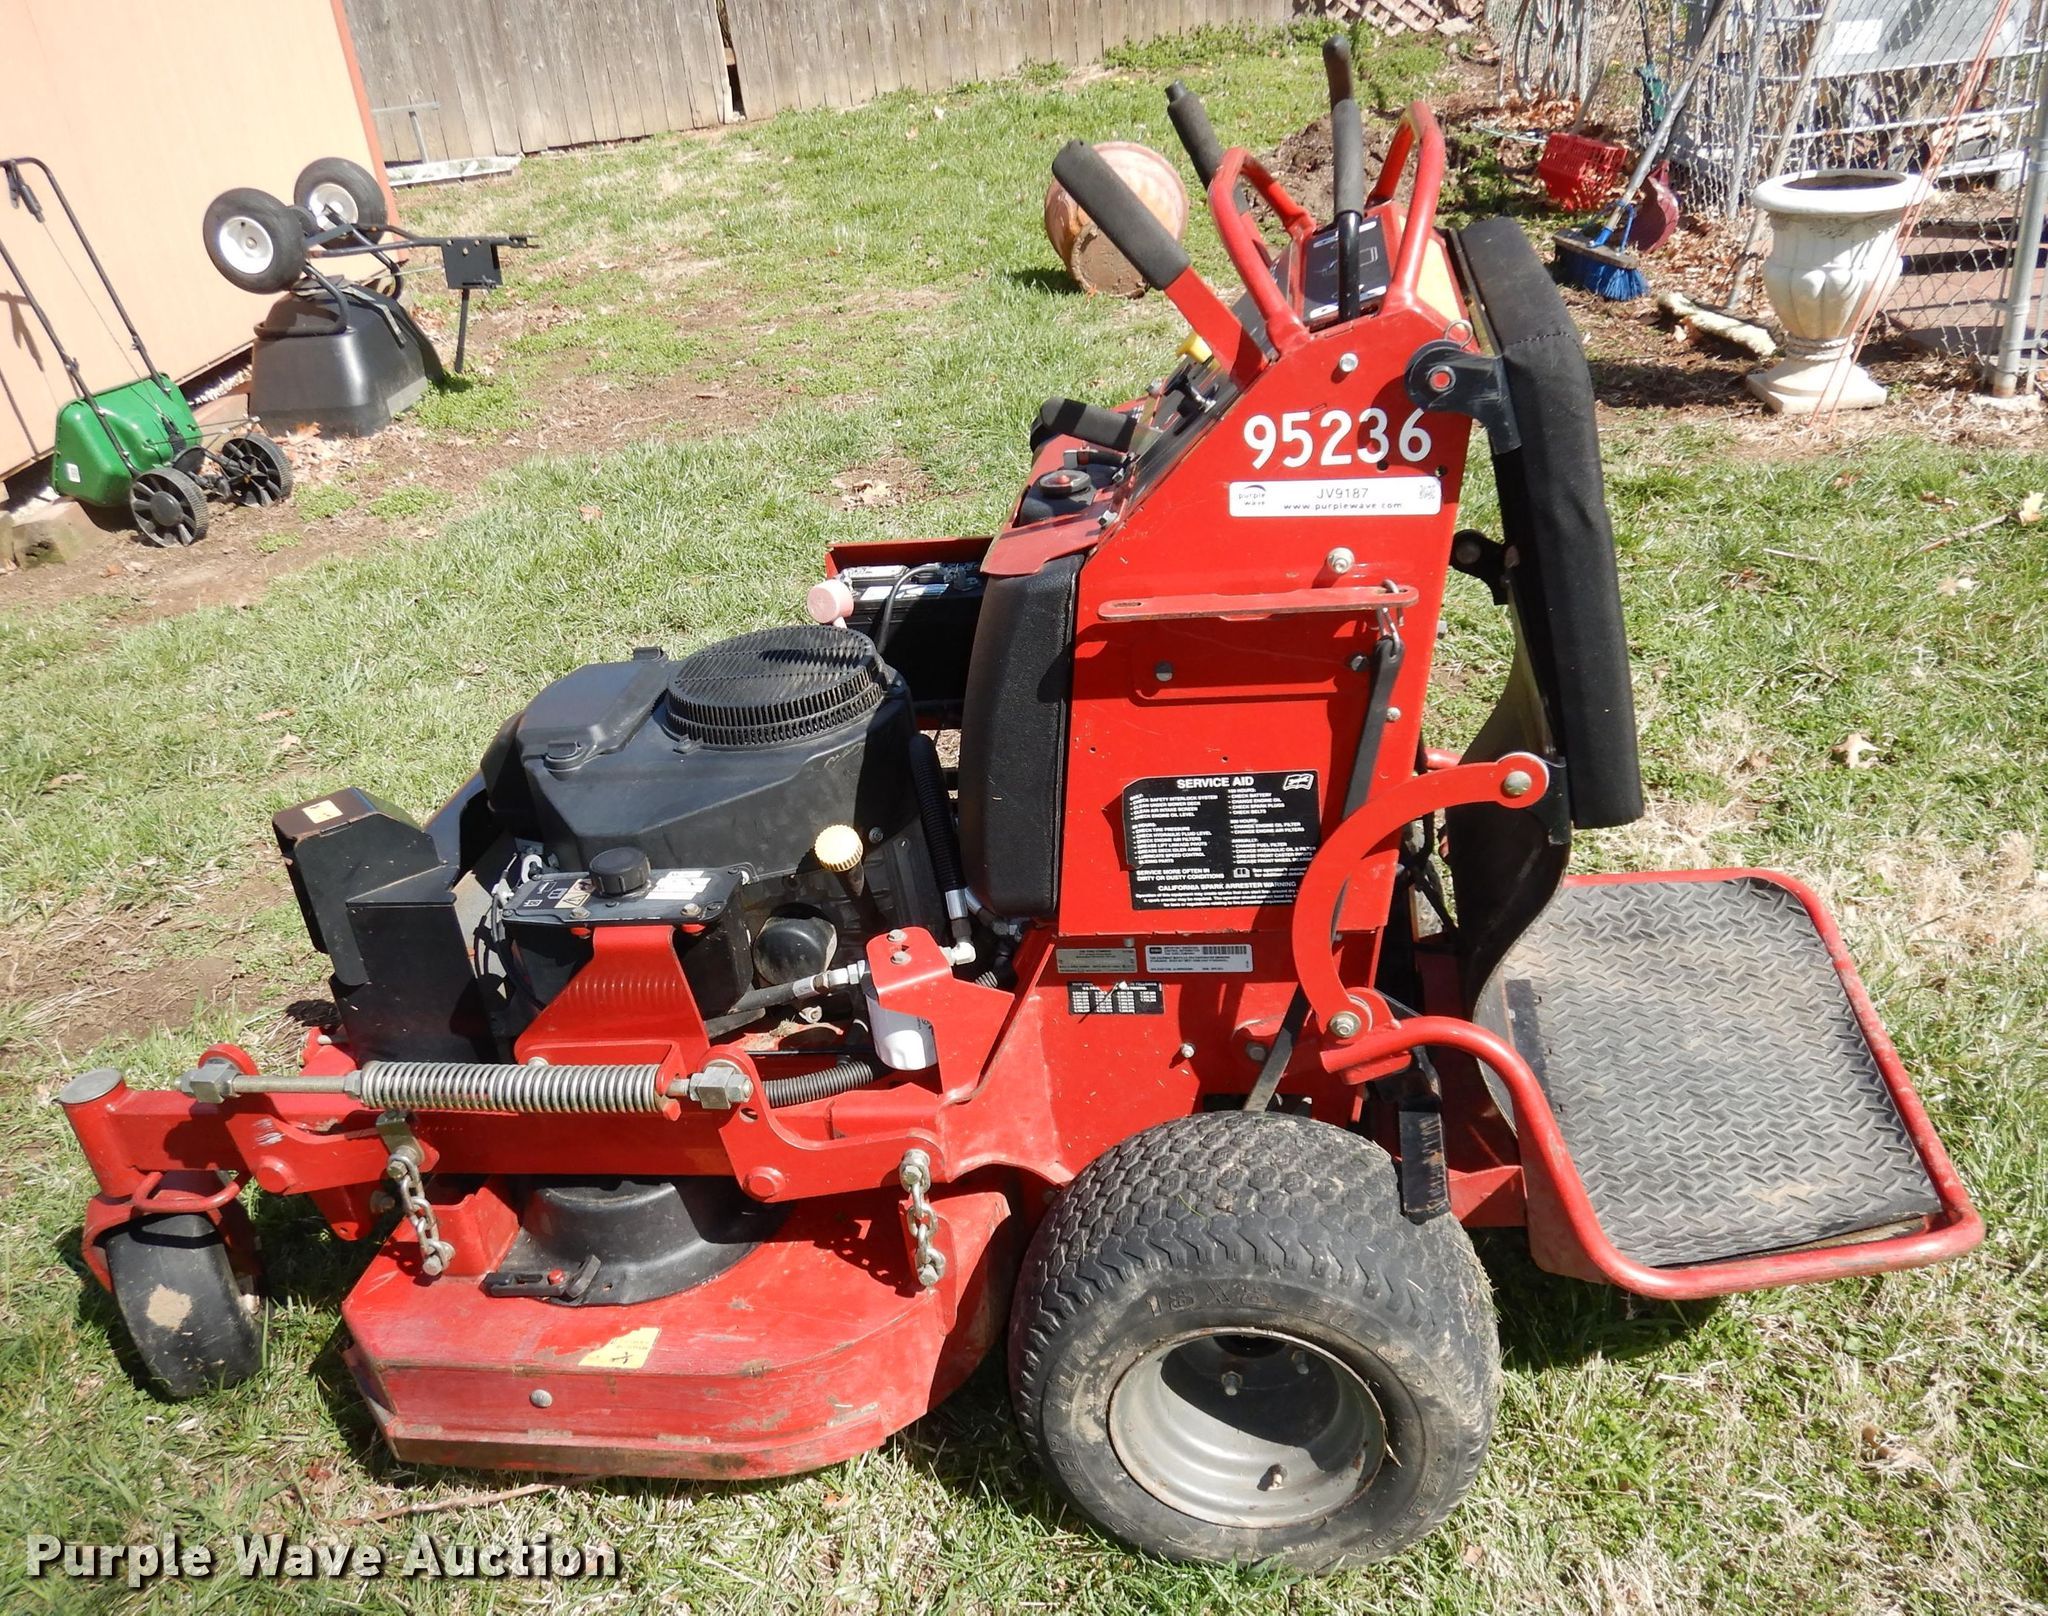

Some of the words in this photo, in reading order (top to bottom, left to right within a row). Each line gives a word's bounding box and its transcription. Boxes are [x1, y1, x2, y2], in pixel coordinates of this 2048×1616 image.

[1243, 407, 1432, 470] 95236
[1238, 492, 1266, 501] purple
[1316, 487, 1369, 500] JV9187
[1177, 777, 1230, 789] SERVICE
[1232, 776, 1254, 787] AID
